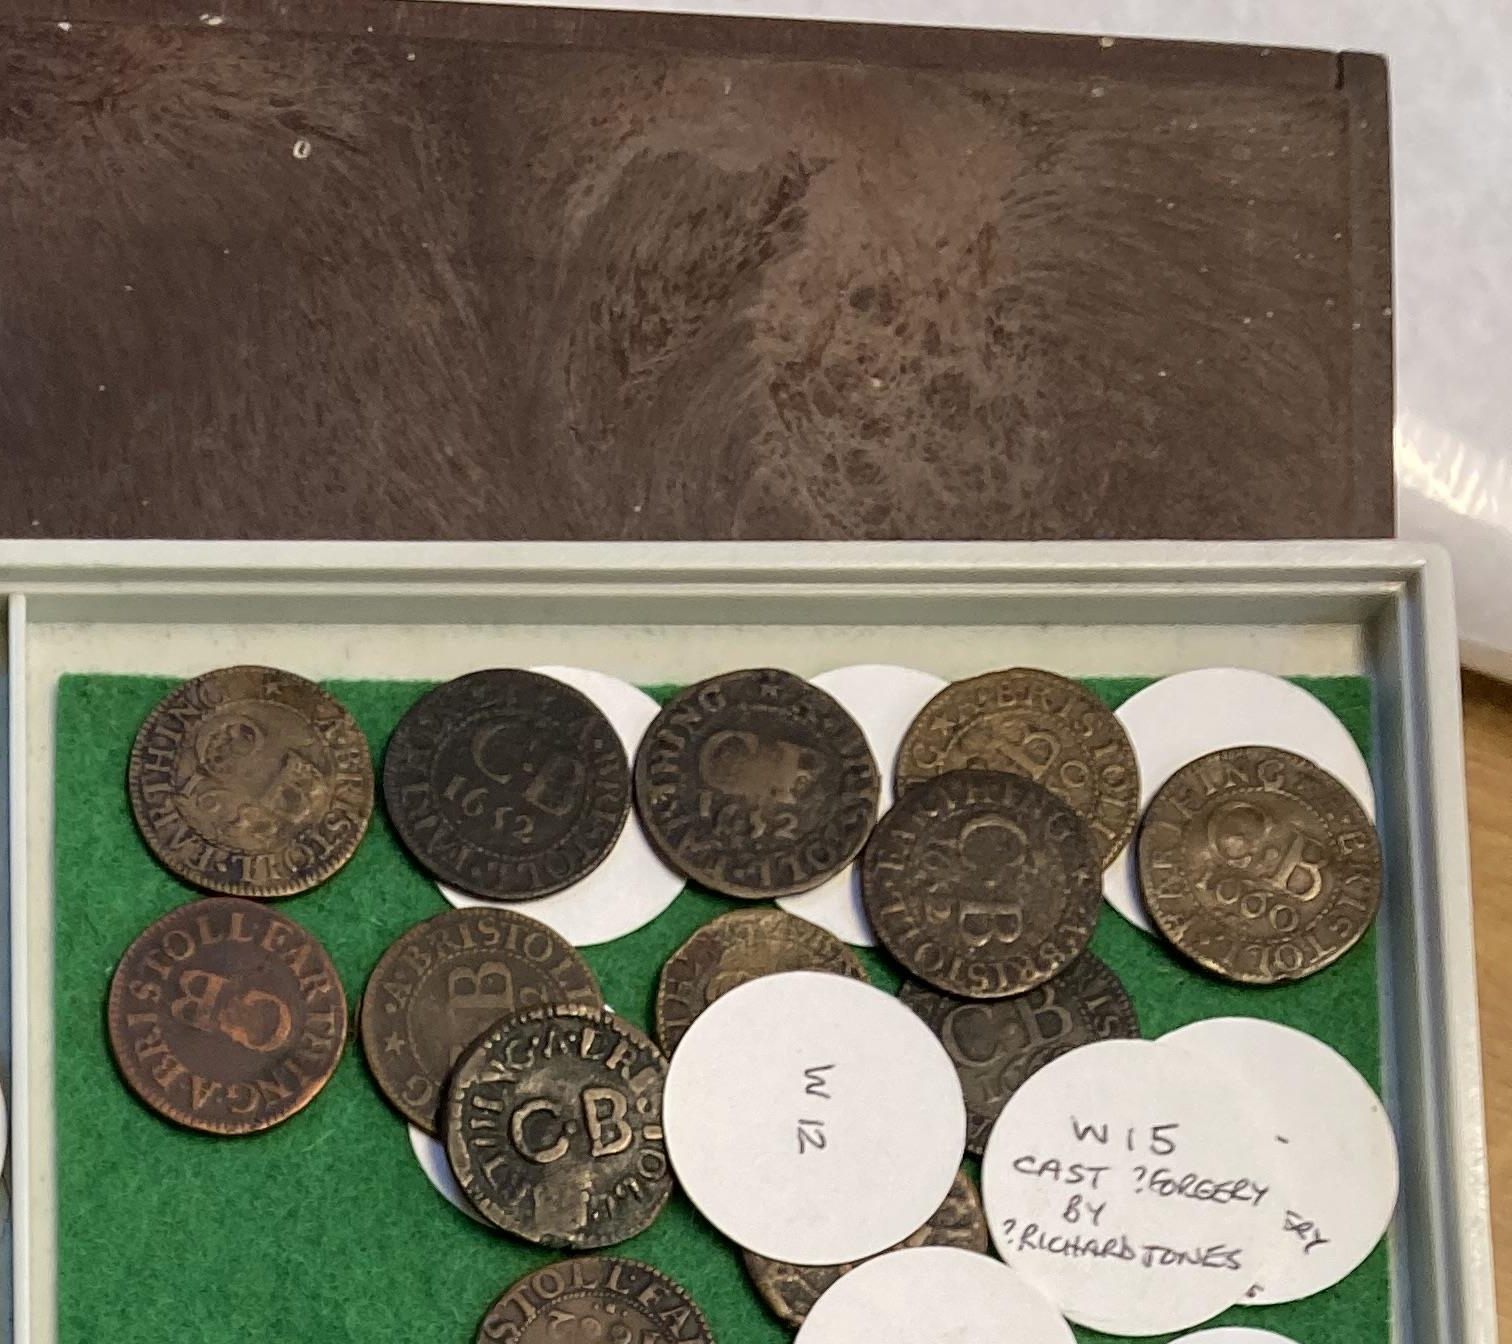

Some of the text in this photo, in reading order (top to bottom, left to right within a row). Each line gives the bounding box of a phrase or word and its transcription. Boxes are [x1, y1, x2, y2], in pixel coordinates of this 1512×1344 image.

[797, 1063, 836, 1155] W 12
[1072, 1120, 1180, 1156] W 15
[1012, 1155, 1111, 1190] CAST
[1061, 1193, 1107, 1227] BY
